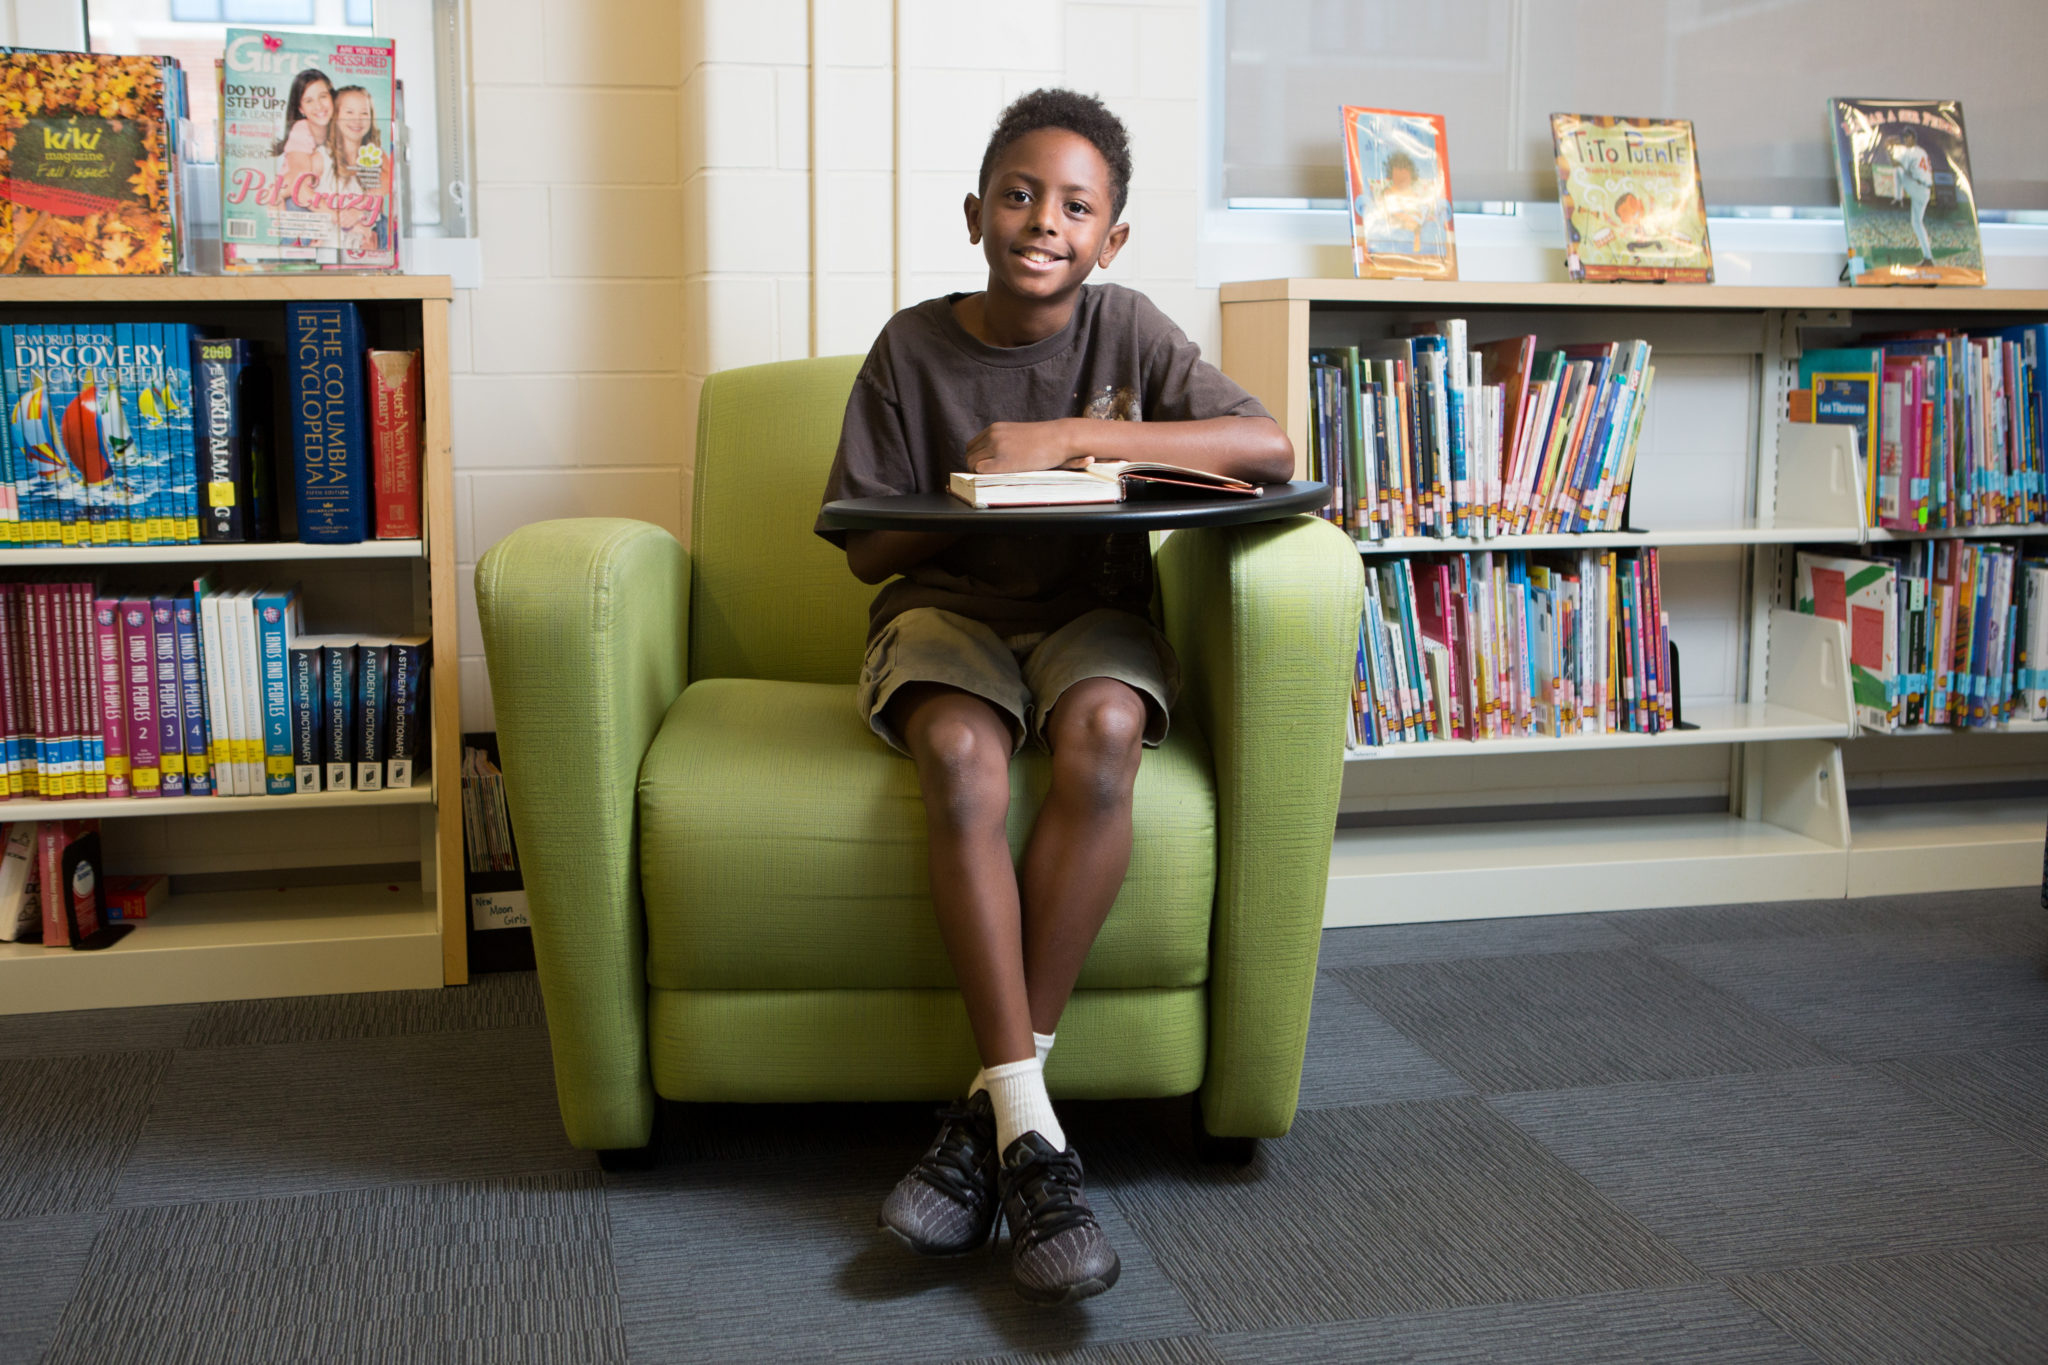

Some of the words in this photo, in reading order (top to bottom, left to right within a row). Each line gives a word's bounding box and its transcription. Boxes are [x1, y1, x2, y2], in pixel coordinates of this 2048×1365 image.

[329, 54, 387, 68] PRESSURED
[339, 46, 353, 54] ARE
[354, 47, 371, 55] YOU
[372, 48, 388, 56] TOO
[227, 85, 246, 96] DO
[249, 86, 276, 97] YOU
[227, 97, 259, 109] STEP
[263, 99, 286, 110] UP?
[43, 127, 103, 150] kiki
[228, 123, 237, 136] 4
[45, 152, 104, 163] magazine
[36, 163, 65, 177] Fall
[227, 167, 288, 206] Pet
[292, 173, 384, 227] Crazy
[27, 334, 75, 346] WORLD
[76, 334, 114, 345] BOOK
[322, 315, 342, 357] THE
[16, 345, 165, 367] DISCOVERY
[202, 345, 232, 359] 2008
[17, 366, 178, 384] ENCYCLOPEDIA
[209, 375, 230, 436] WORLD
[298, 315, 324, 484] ENCYCLOPEDIA
[1820, 402, 1831, 413] Los
[1832, 401, 1866, 414] Tiburones
[324, 363, 348, 483] COLUMBIA
[394, 421, 408, 450] New
[210, 437, 231, 518] ALMAC
[395, 451, 410, 493] World
[100, 633, 117, 661] LANDS
[129, 636, 146, 663] LANDS
[157, 633, 174, 660] LANDS
[180, 633, 197, 660] LANDS
[265, 632, 282, 659] LANDS
[103, 665, 119, 682] AND
[132, 665, 148, 683] AND
[159, 663, 175, 680] AND
[182, 663, 199, 680] AND
[267, 662, 283, 679] AND
[397, 656, 406, 704] STUDENT'S
[299, 661, 309, 709] STUDENT'S
[333, 659, 342, 707] STUDENT'S
[366, 658, 376, 707] STUDENT'S
[104, 685, 121, 720] PEOPLES
[132, 686, 150, 721] PEOPLES
[160, 683, 176, 719] PEOPLES
[184, 683, 202, 719] PEOPLES
[268, 682, 285, 717] PEOPLES
[111, 726, 118, 737] 1
[139, 727, 147, 739] 2
[166, 725, 174, 736] 3
[192, 725, 200, 736] 4
[274, 724, 282, 735] 5
[301, 710, 311, 763] DICTIONARY
[334, 708, 343, 761] DICTIONARY
[365, 708, 375, 760] DICTIONARY
[395, 705, 405, 758] DICTIONARY
[47, 837, 55, 847] The
[475, 897, 493, 906] New
[489, 905, 513, 916] Moon
[503, 914, 527, 926] Girls
